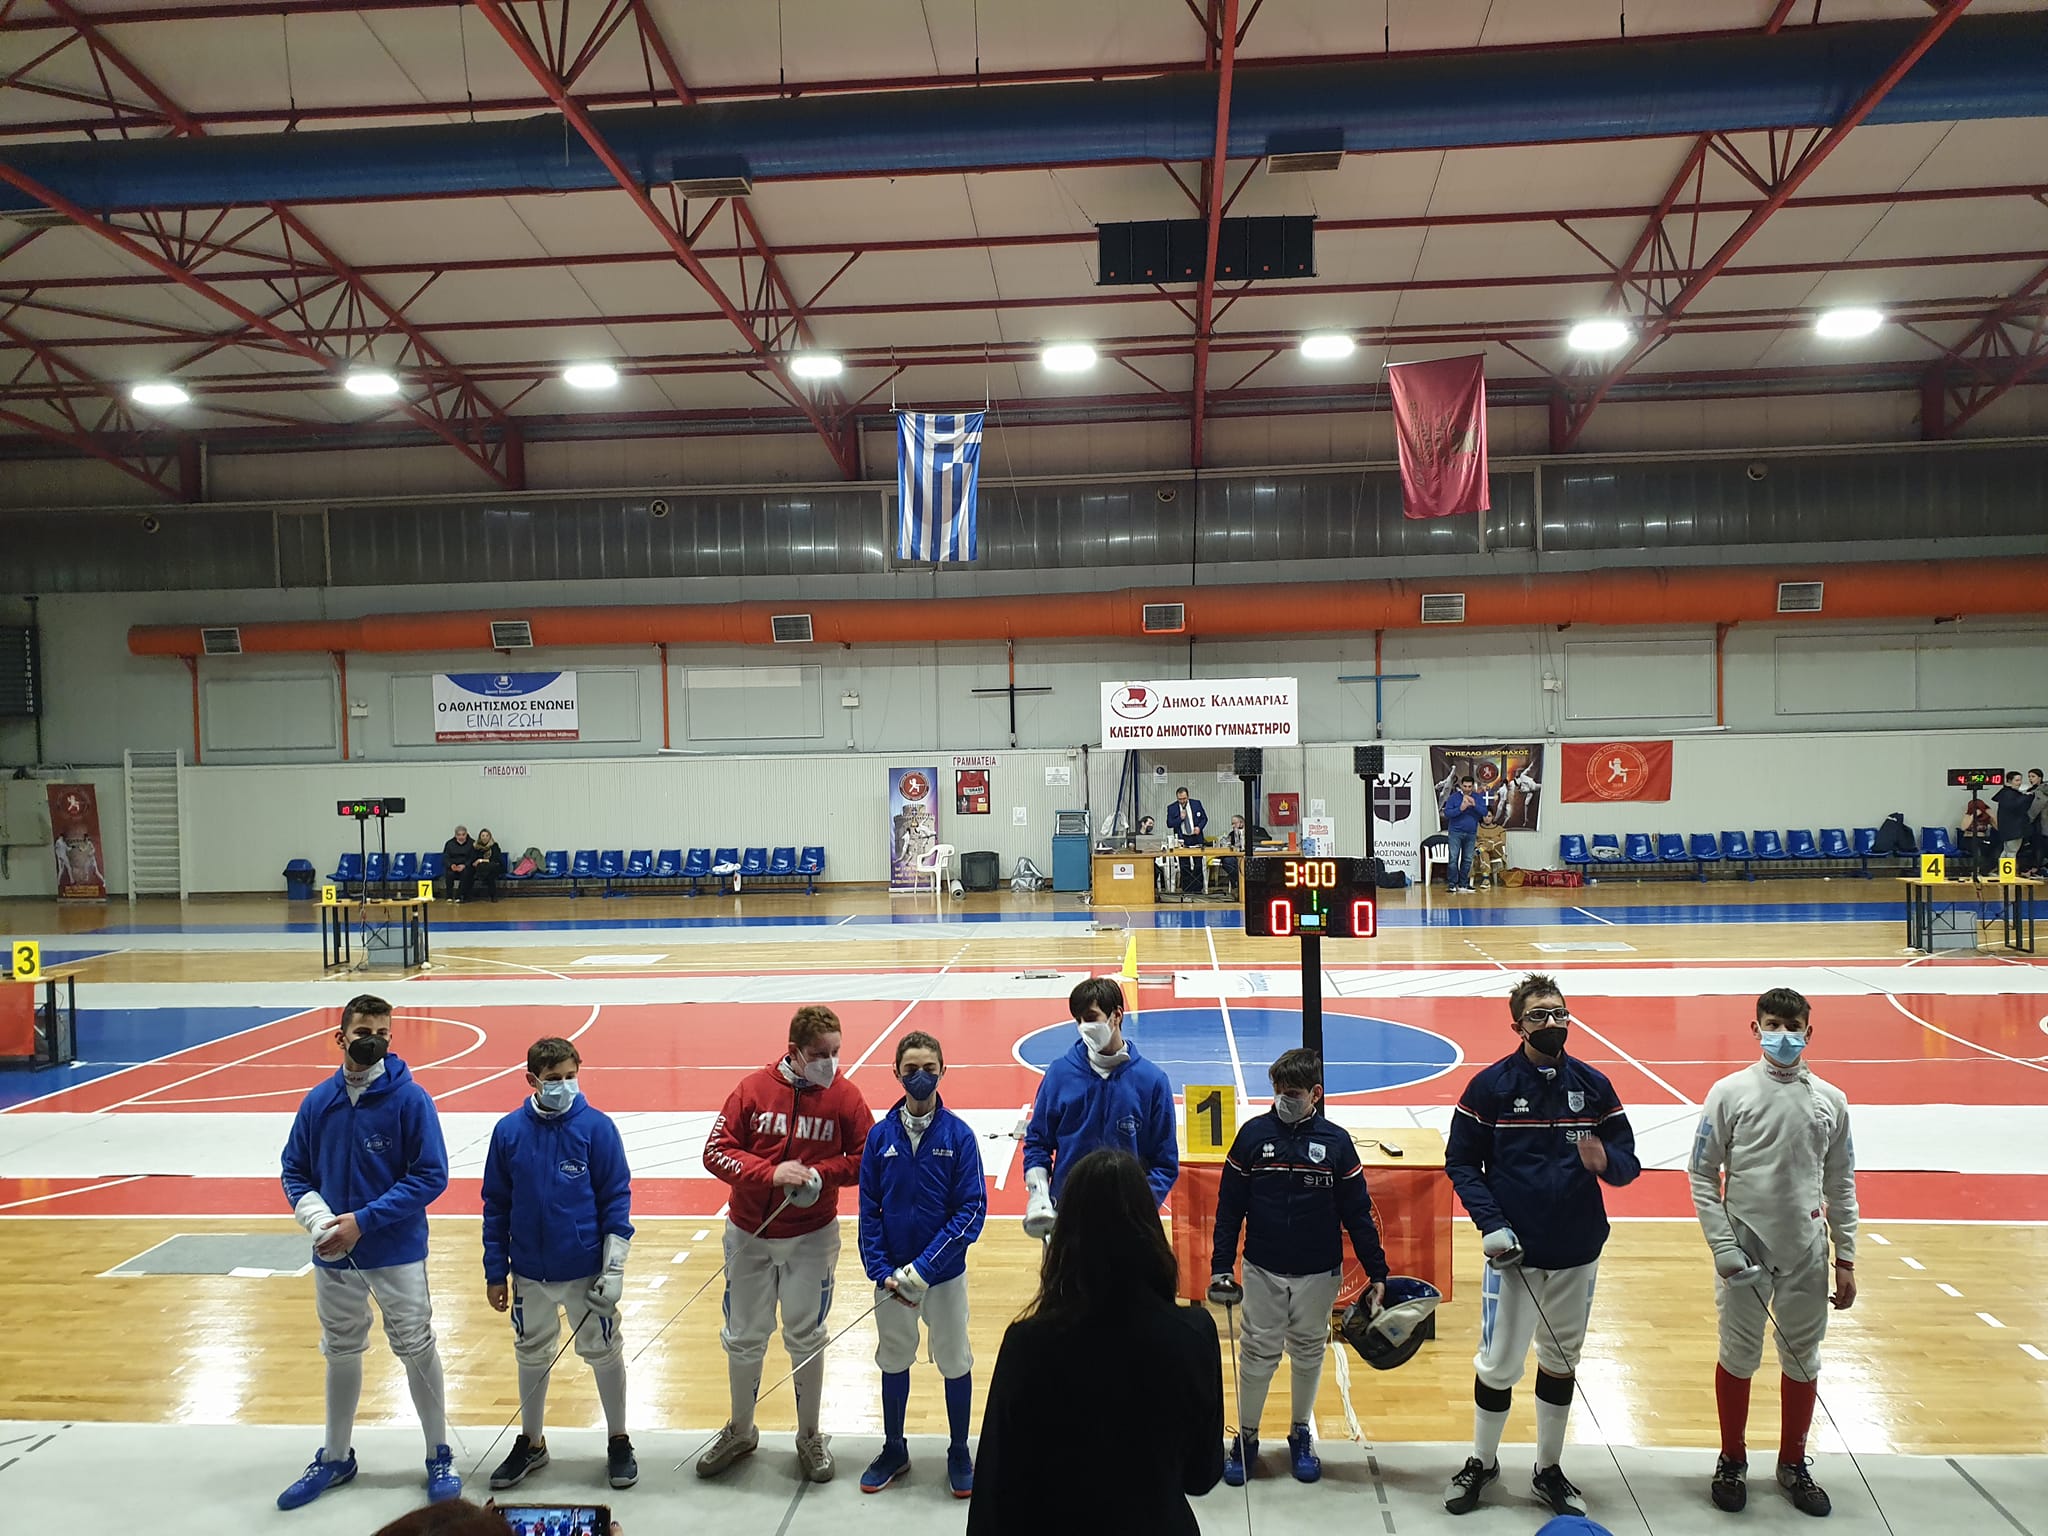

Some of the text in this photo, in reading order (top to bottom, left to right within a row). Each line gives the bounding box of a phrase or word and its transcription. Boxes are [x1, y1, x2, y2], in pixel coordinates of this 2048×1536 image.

[438, 700, 574, 712] Ο ΑΘΛΗΤΙΣΜΟΣ ΕΝΩΝΕΙ
[1162, 696, 1206, 709] ΔΗΜΟΣ
[466, 712, 543, 729] ΕΙΝΑΙ ΖΩΗ
[1110, 722, 1291, 738] ΚΛΕΙΣΤΟ ΔΗΜΟΤΙΚΟ ΓΥΜΝΑΣΤΗΡΙΟ
[952, 756, 996, 766] ΓΡΑΜΜΑΤΕΙΑ
[484, 766, 527, 776] ΓΗΠΕΔΟΥΧΟΙ
[1284, 861, 1335, 887] 3:00
[1926, 858, 1941, 876] 4
[2002, 861, 2013, 875] 6
[325, 888, 333, 900] 5
[421, 884, 430, 896] 7
[1271, 900, 1291, 935] 0
[1353, 901, 1374, 936] 0
[17, 945, 36, 975] 3
[1196, 1090, 1223, 1147] 1
